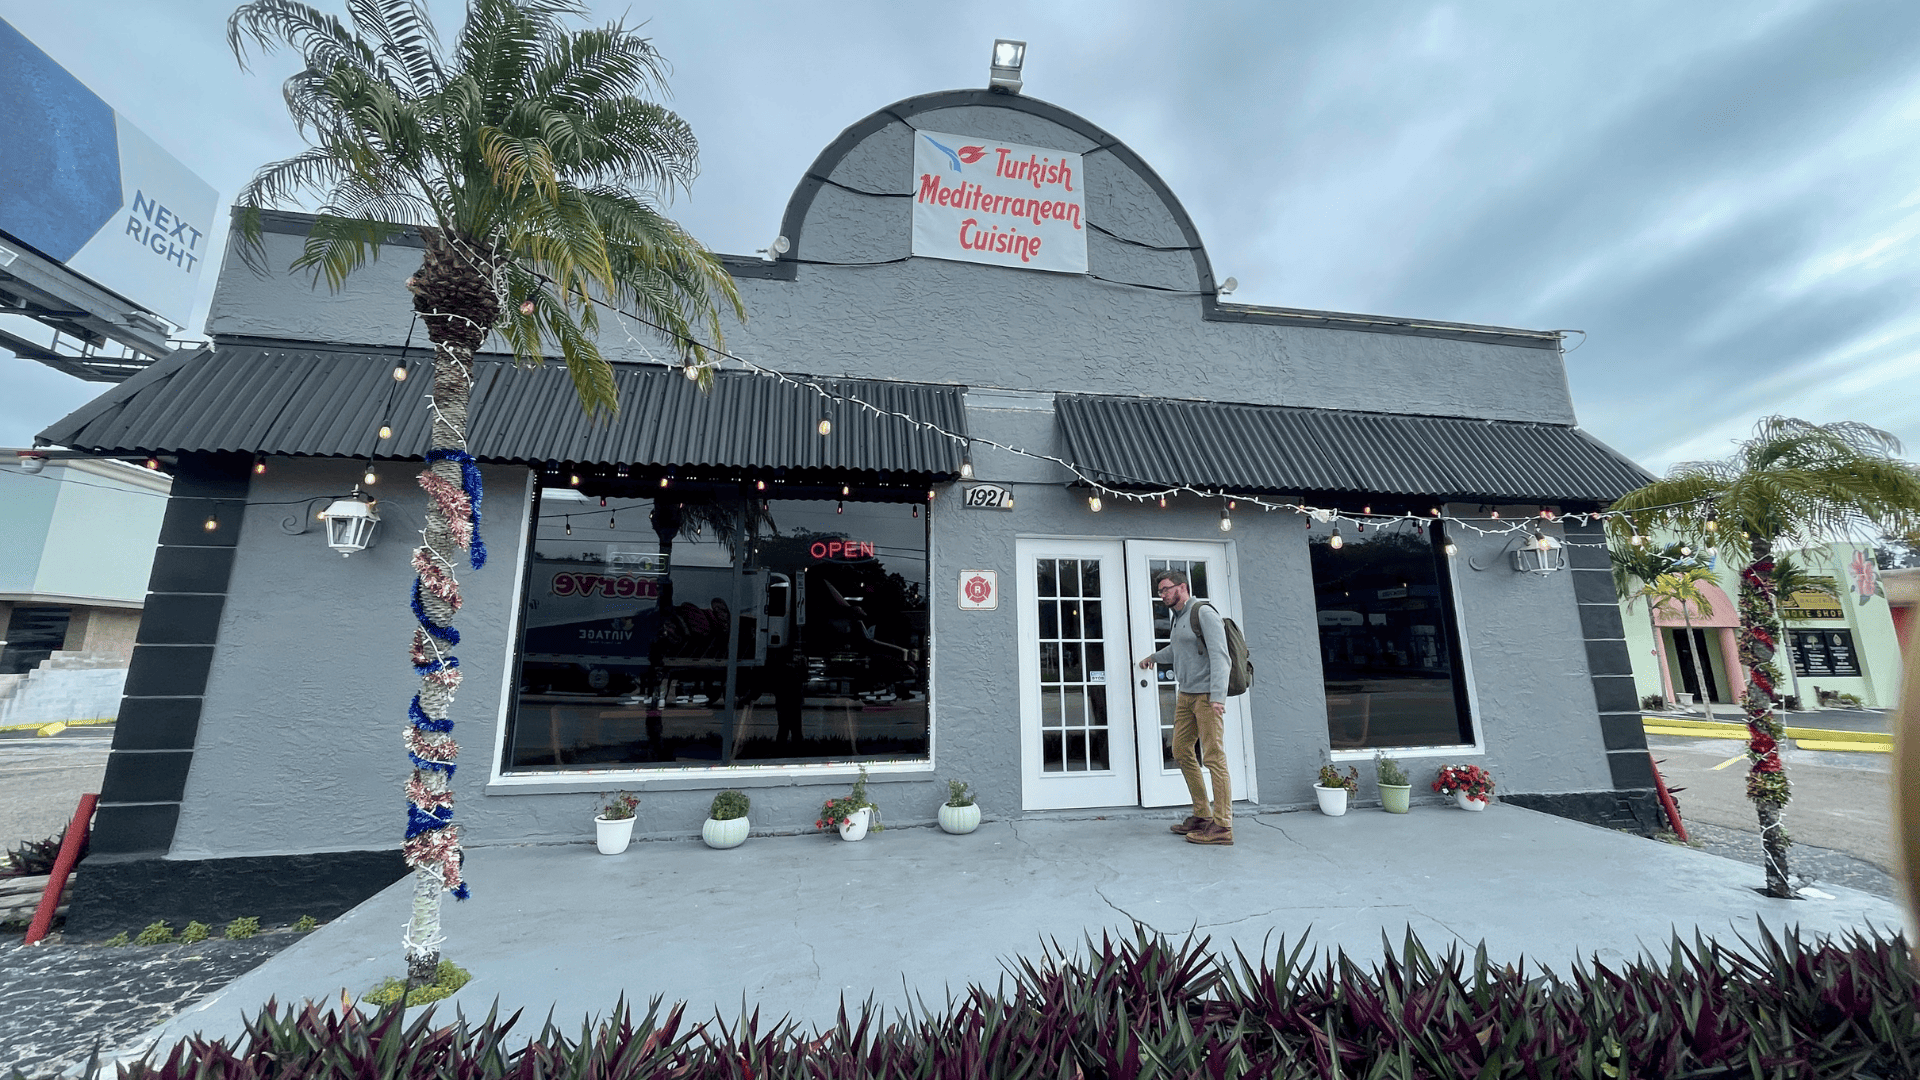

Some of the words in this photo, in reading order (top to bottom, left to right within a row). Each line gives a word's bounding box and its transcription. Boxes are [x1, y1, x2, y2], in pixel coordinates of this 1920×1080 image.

[995, 147, 1073, 192] Turkish
[132, 189, 203, 251] NEXT
[918, 173, 1082, 230] Mediterranean
[125, 215, 198, 273] RIGHT
[959, 217, 1042, 262] Cuisine
[966, 488, 1006, 507] 1921
[810, 541, 875, 558] OPEN
[1777, 609, 1812, 618] MOKE
